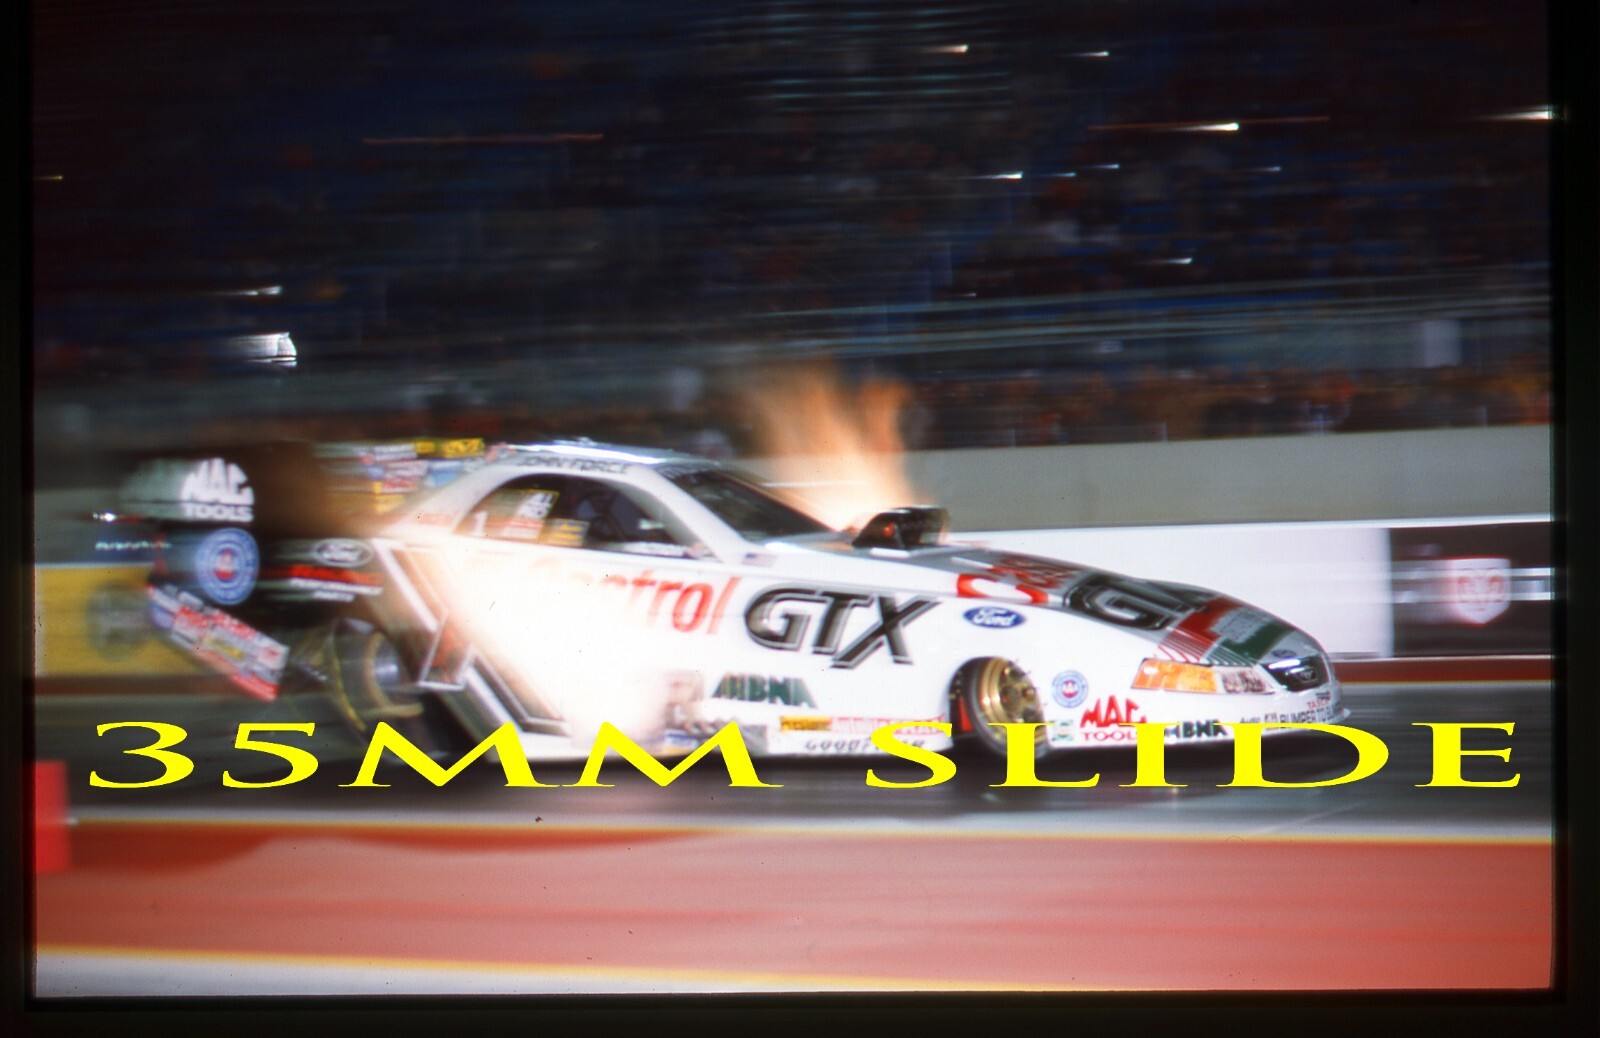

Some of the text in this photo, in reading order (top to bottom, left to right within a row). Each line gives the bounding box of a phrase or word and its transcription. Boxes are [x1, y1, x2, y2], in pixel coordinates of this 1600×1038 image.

[180, 457, 254, 503] MAC
[183, 503, 254, 522] TOOLS
[743, 581, 942, 669] GTX
[1079, 694, 1147, 728] MAC
[1081, 730, 1139, 742] TOOL
